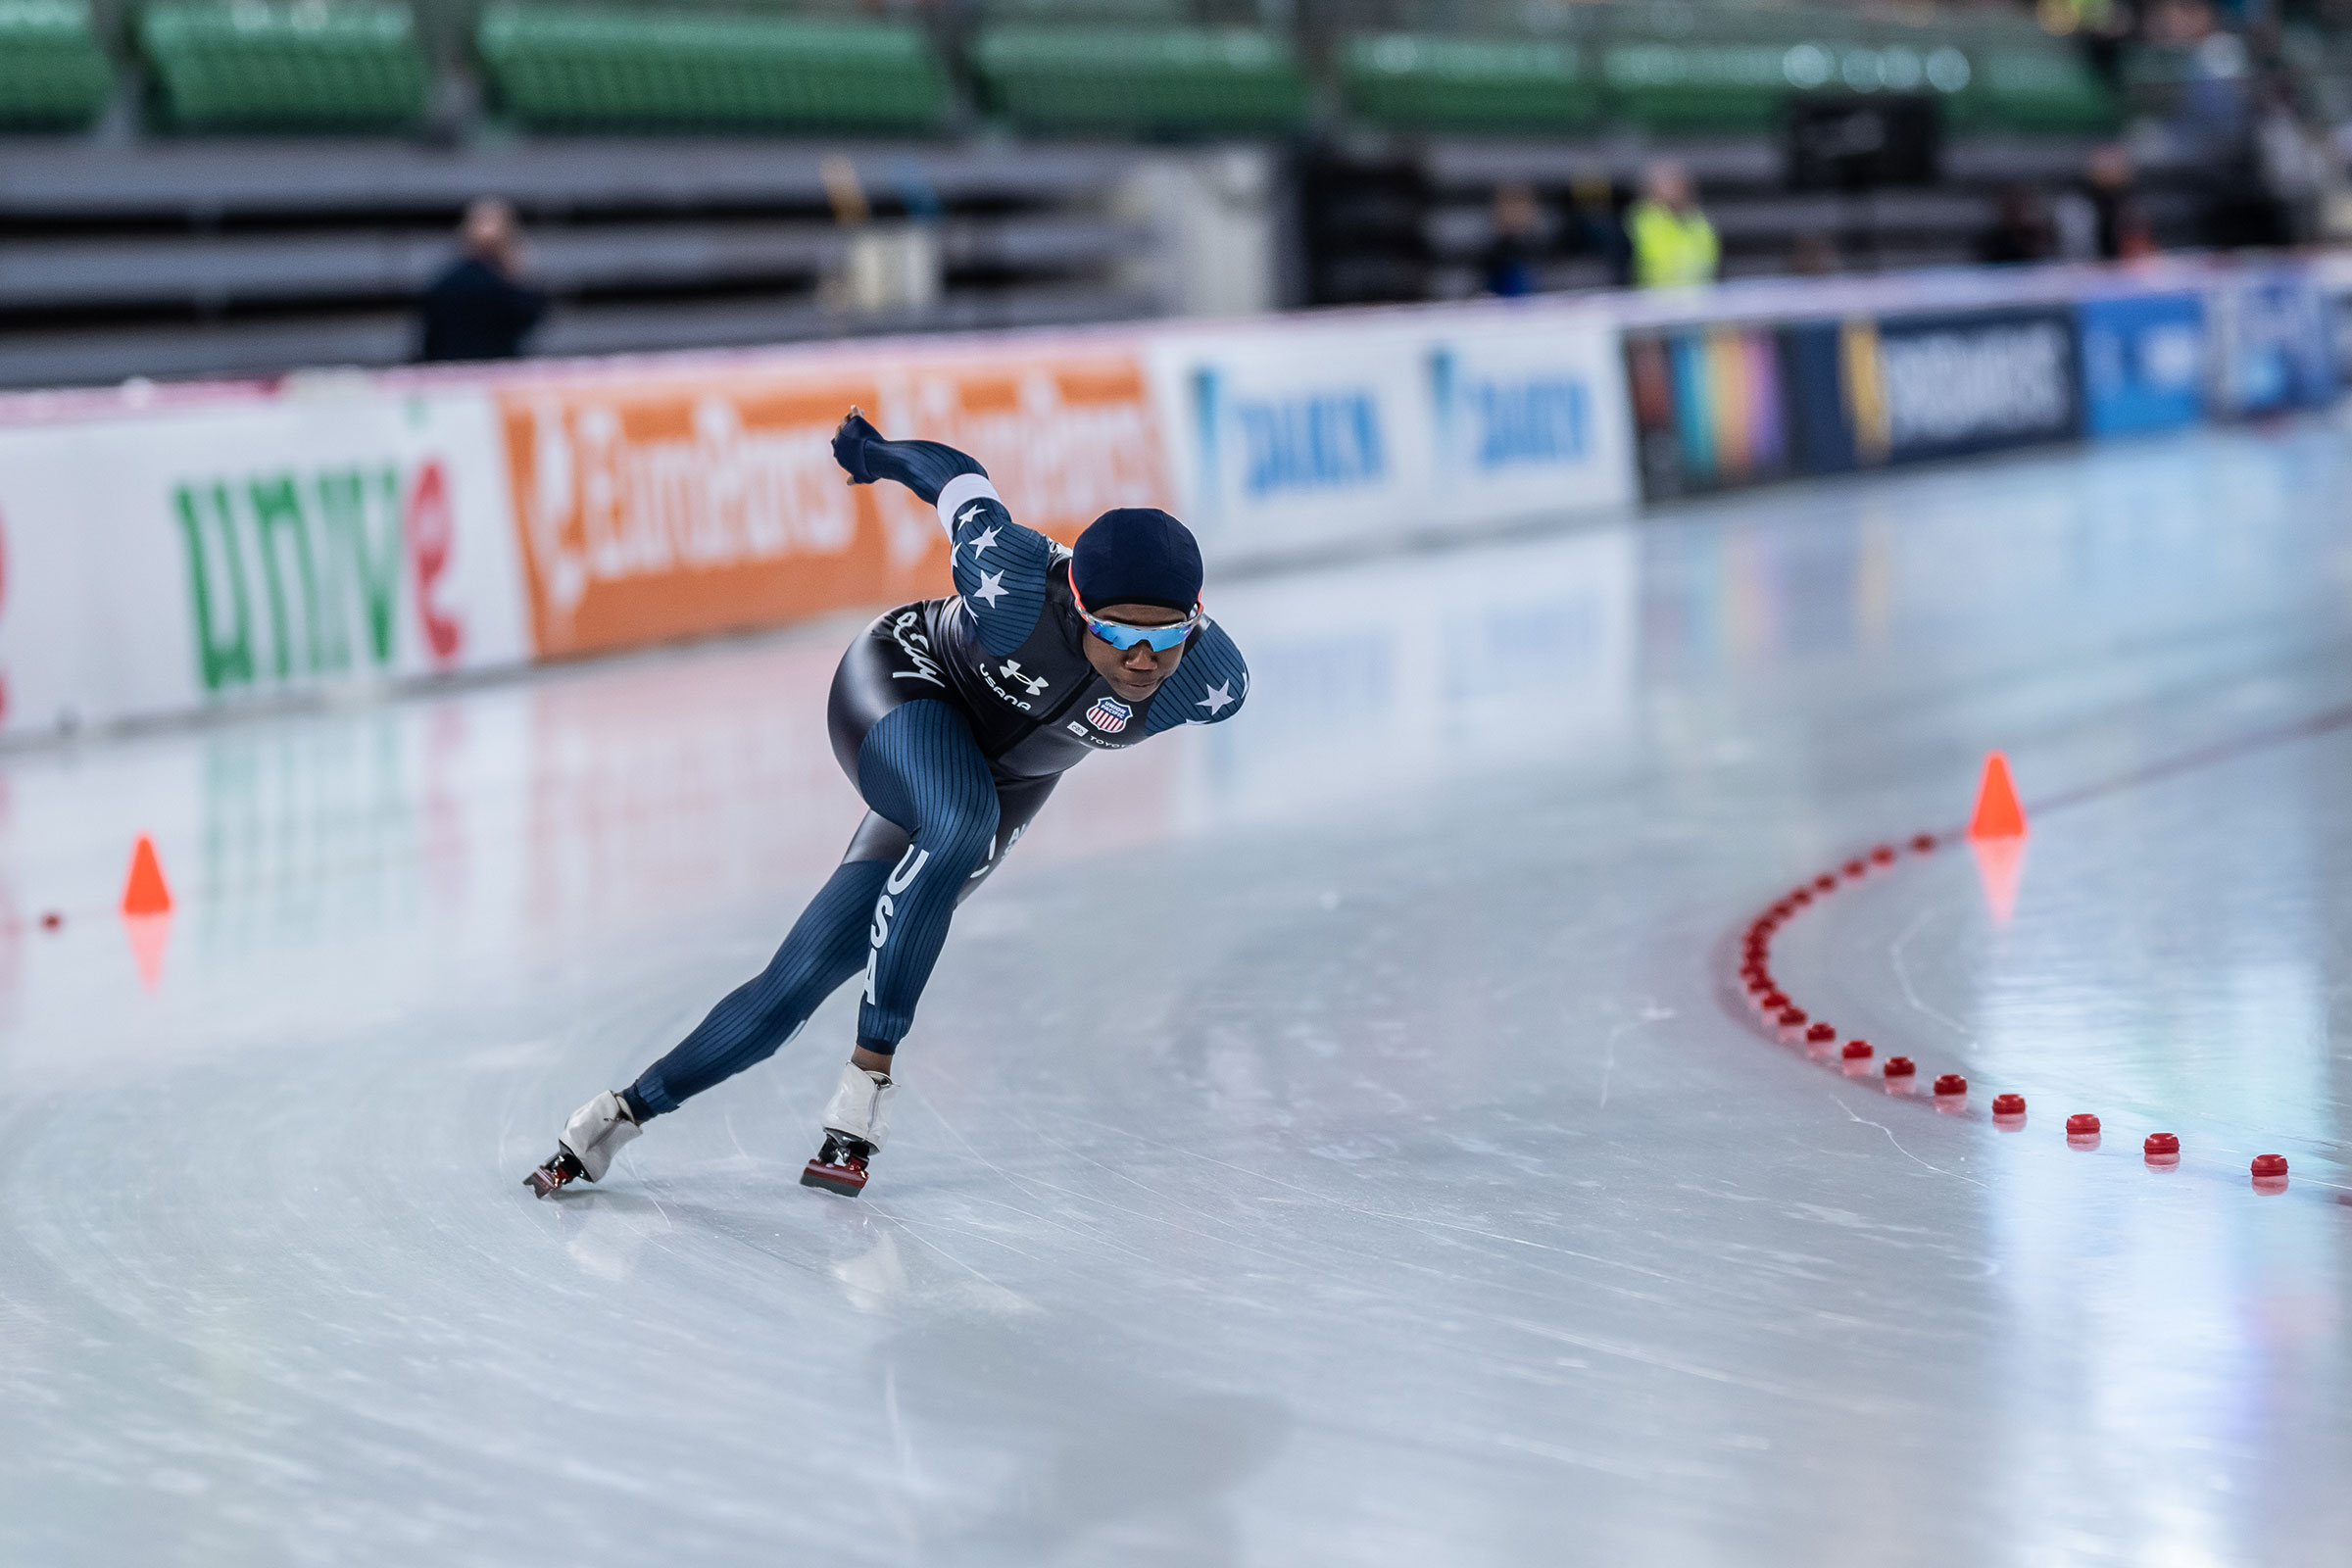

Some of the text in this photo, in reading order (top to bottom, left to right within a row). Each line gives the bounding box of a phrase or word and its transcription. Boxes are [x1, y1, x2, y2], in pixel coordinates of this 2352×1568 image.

[979, 662, 1032, 711] USANA
[1100, 705, 1126, 719] PACIFIC
[1103, 701, 1127, 714] UNION
[1090, 735, 1125, 749] TOYO
[862, 843, 930, 1006] USA
